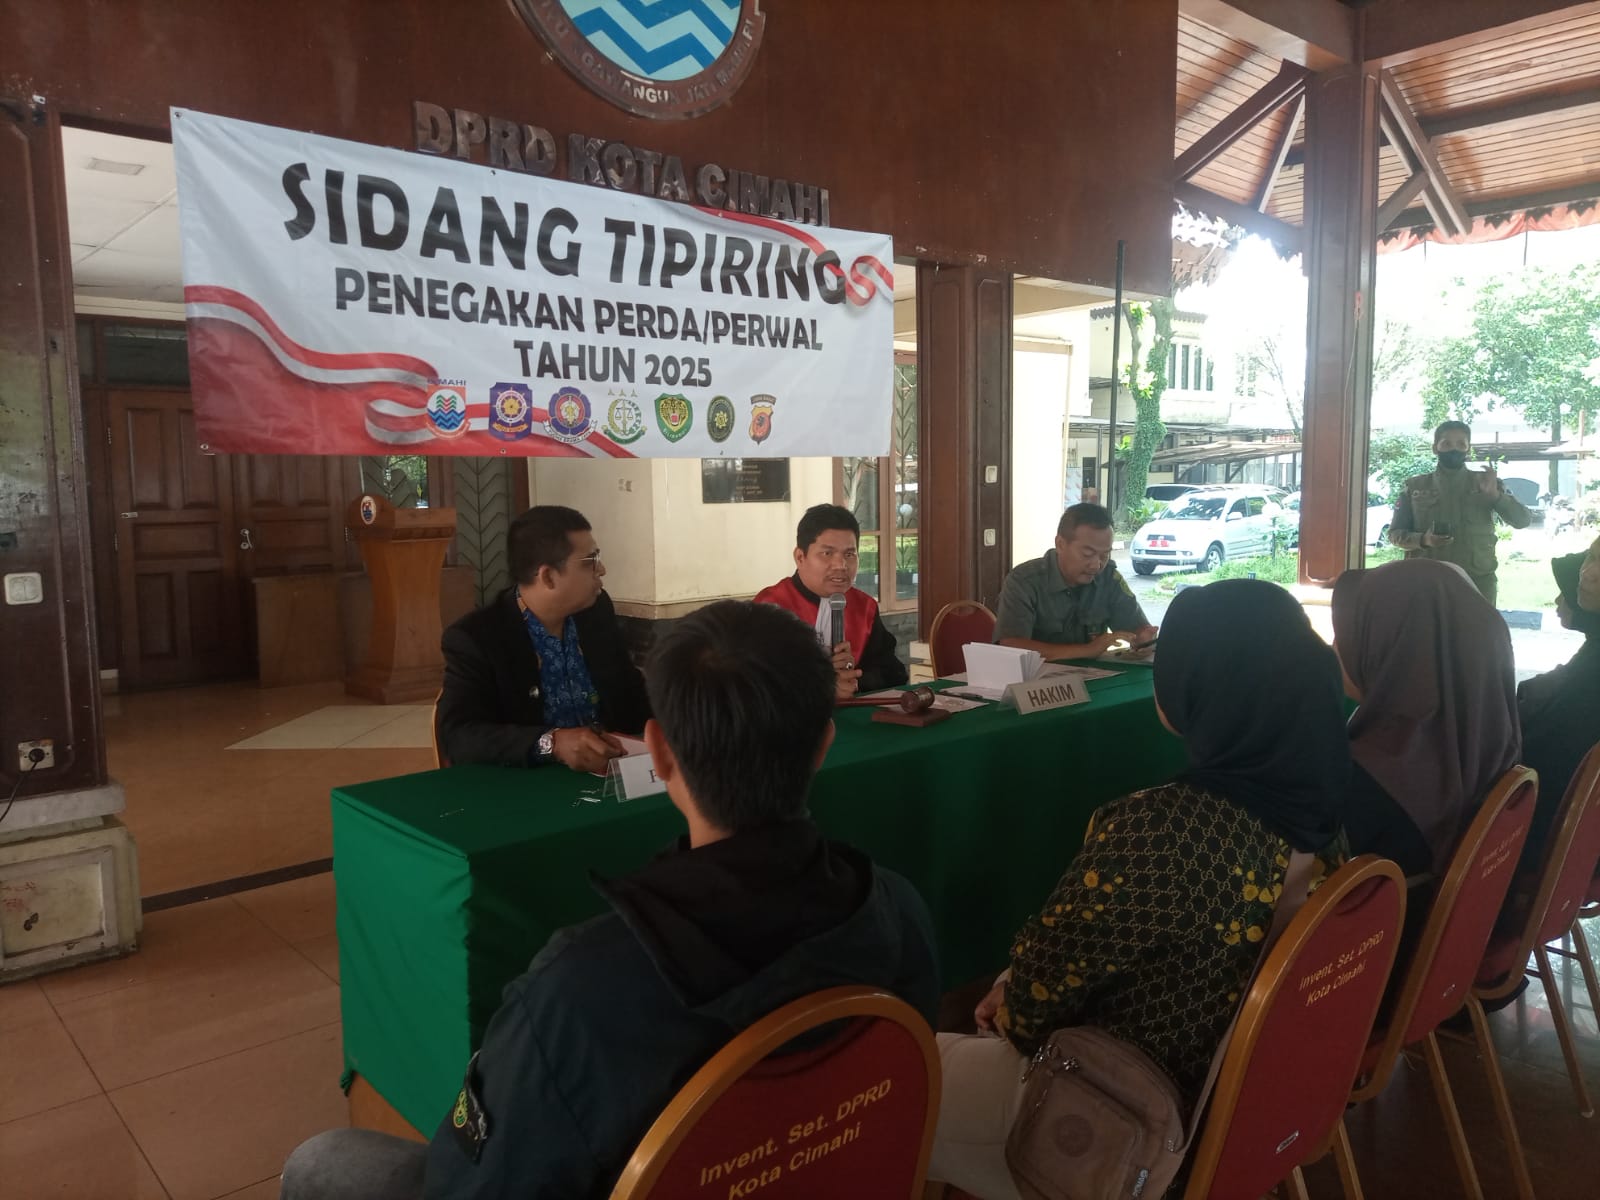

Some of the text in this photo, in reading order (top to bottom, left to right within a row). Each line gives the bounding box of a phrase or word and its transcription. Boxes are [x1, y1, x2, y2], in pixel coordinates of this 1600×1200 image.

[413, 100, 830, 228] DPRD KOTA CIMAHI
[282, 162, 847, 305] SIDANG TIPIRING
[335, 267, 823, 351] PENEGAKAN PERDA/PERWAL
[513, 339, 712, 388] TAHUN 2025
[1027, 683, 1075, 707] HAKIM
[700, 1079, 892, 1186] Invent. Set. DPRD
[728, 1121, 861, 1200] Kota Cimahi
